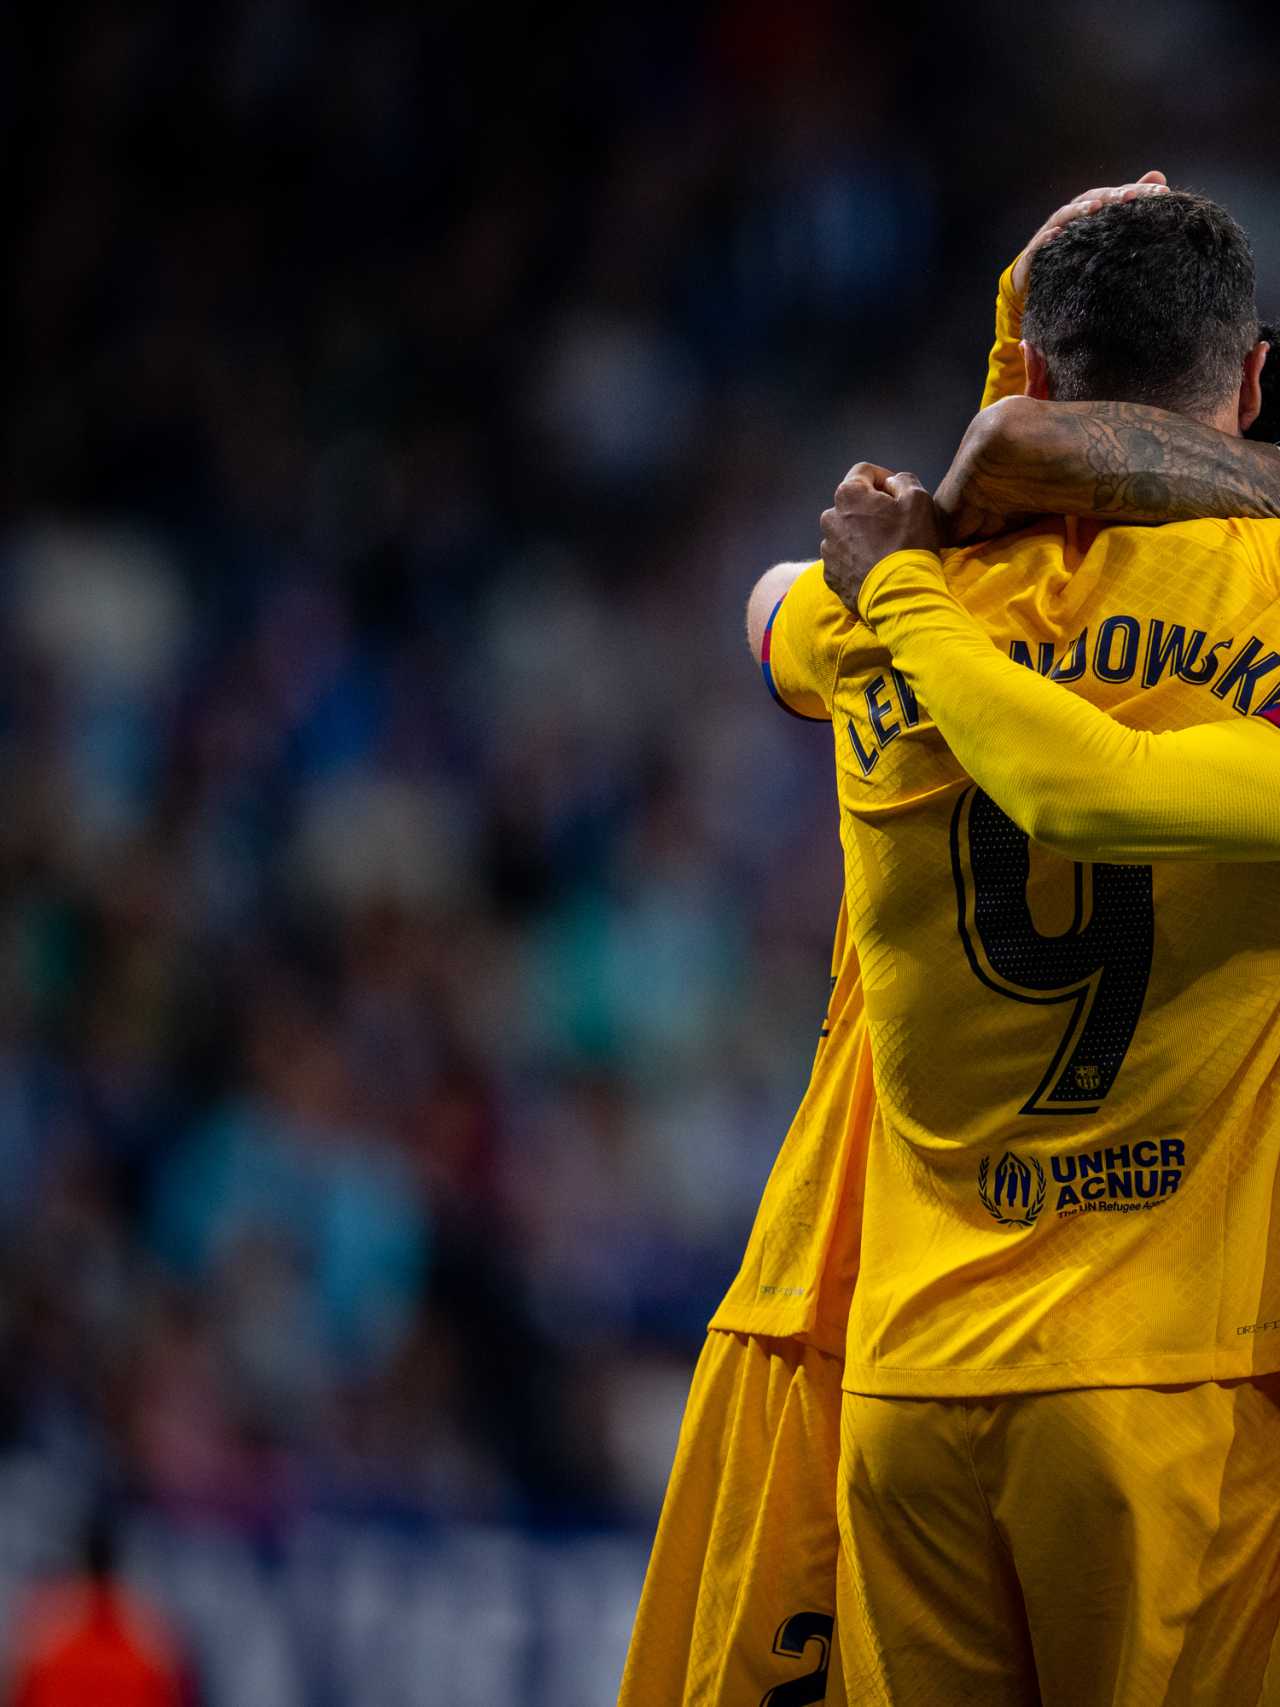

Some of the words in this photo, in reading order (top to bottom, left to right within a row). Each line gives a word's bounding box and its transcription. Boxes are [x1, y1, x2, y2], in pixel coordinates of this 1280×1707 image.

[950, 784, 1155, 1115] 9
[1050, 1138, 1186, 1183] UNHCR
[1055, 1169, 1182, 1211] ACNUR
[1079, 1202, 1097, 1212] UN
[1099, 1201, 1141, 1214] Refugee
